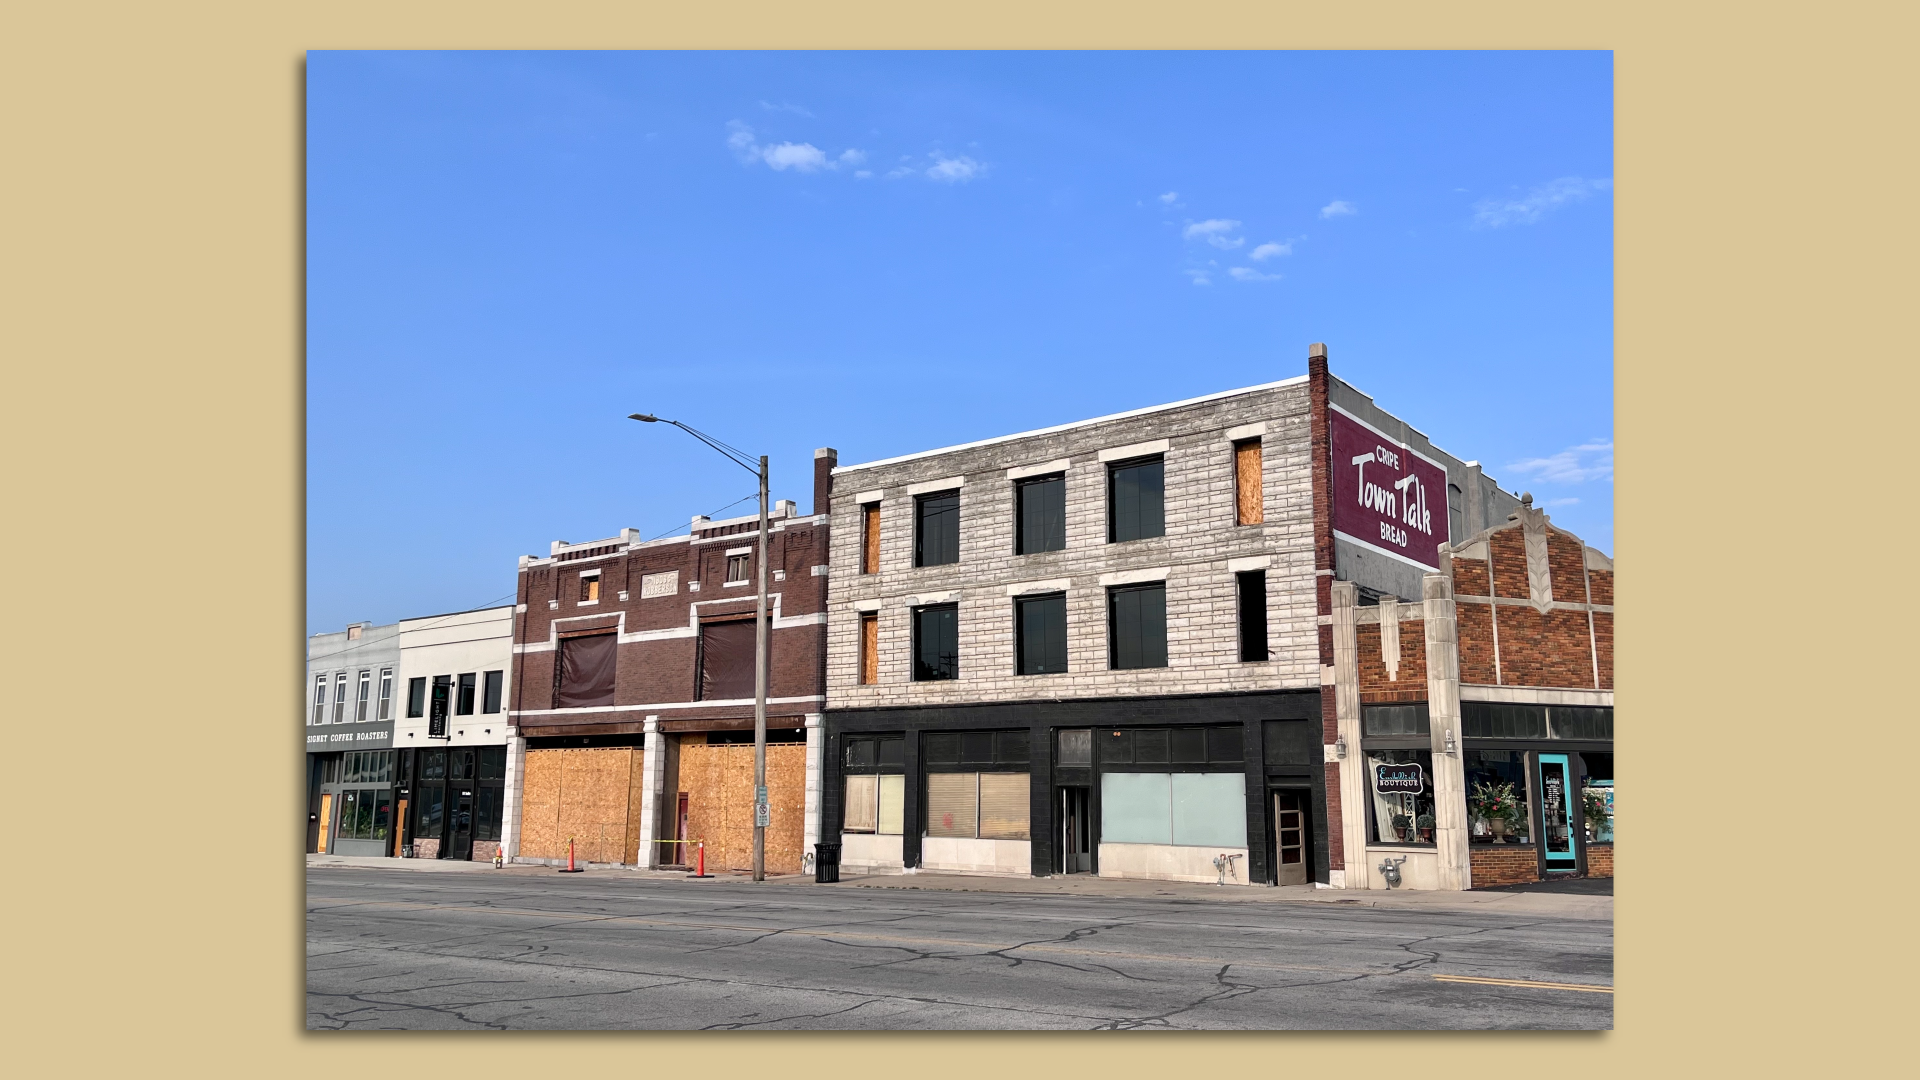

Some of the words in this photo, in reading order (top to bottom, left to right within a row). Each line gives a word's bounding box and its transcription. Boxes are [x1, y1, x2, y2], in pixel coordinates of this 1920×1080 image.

[1376, 444, 1400, 471] CRIPE
[1352, 452, 1396, 519] Town
[1394, 473, 1432, 536] Talk
[1380, 521, 1408, 548] BREAD
[307, 734, 328, 743] SIGNET
[330, 733, 354, 742] COFFEE
[356, 731, 389, 741] ROASTERS
